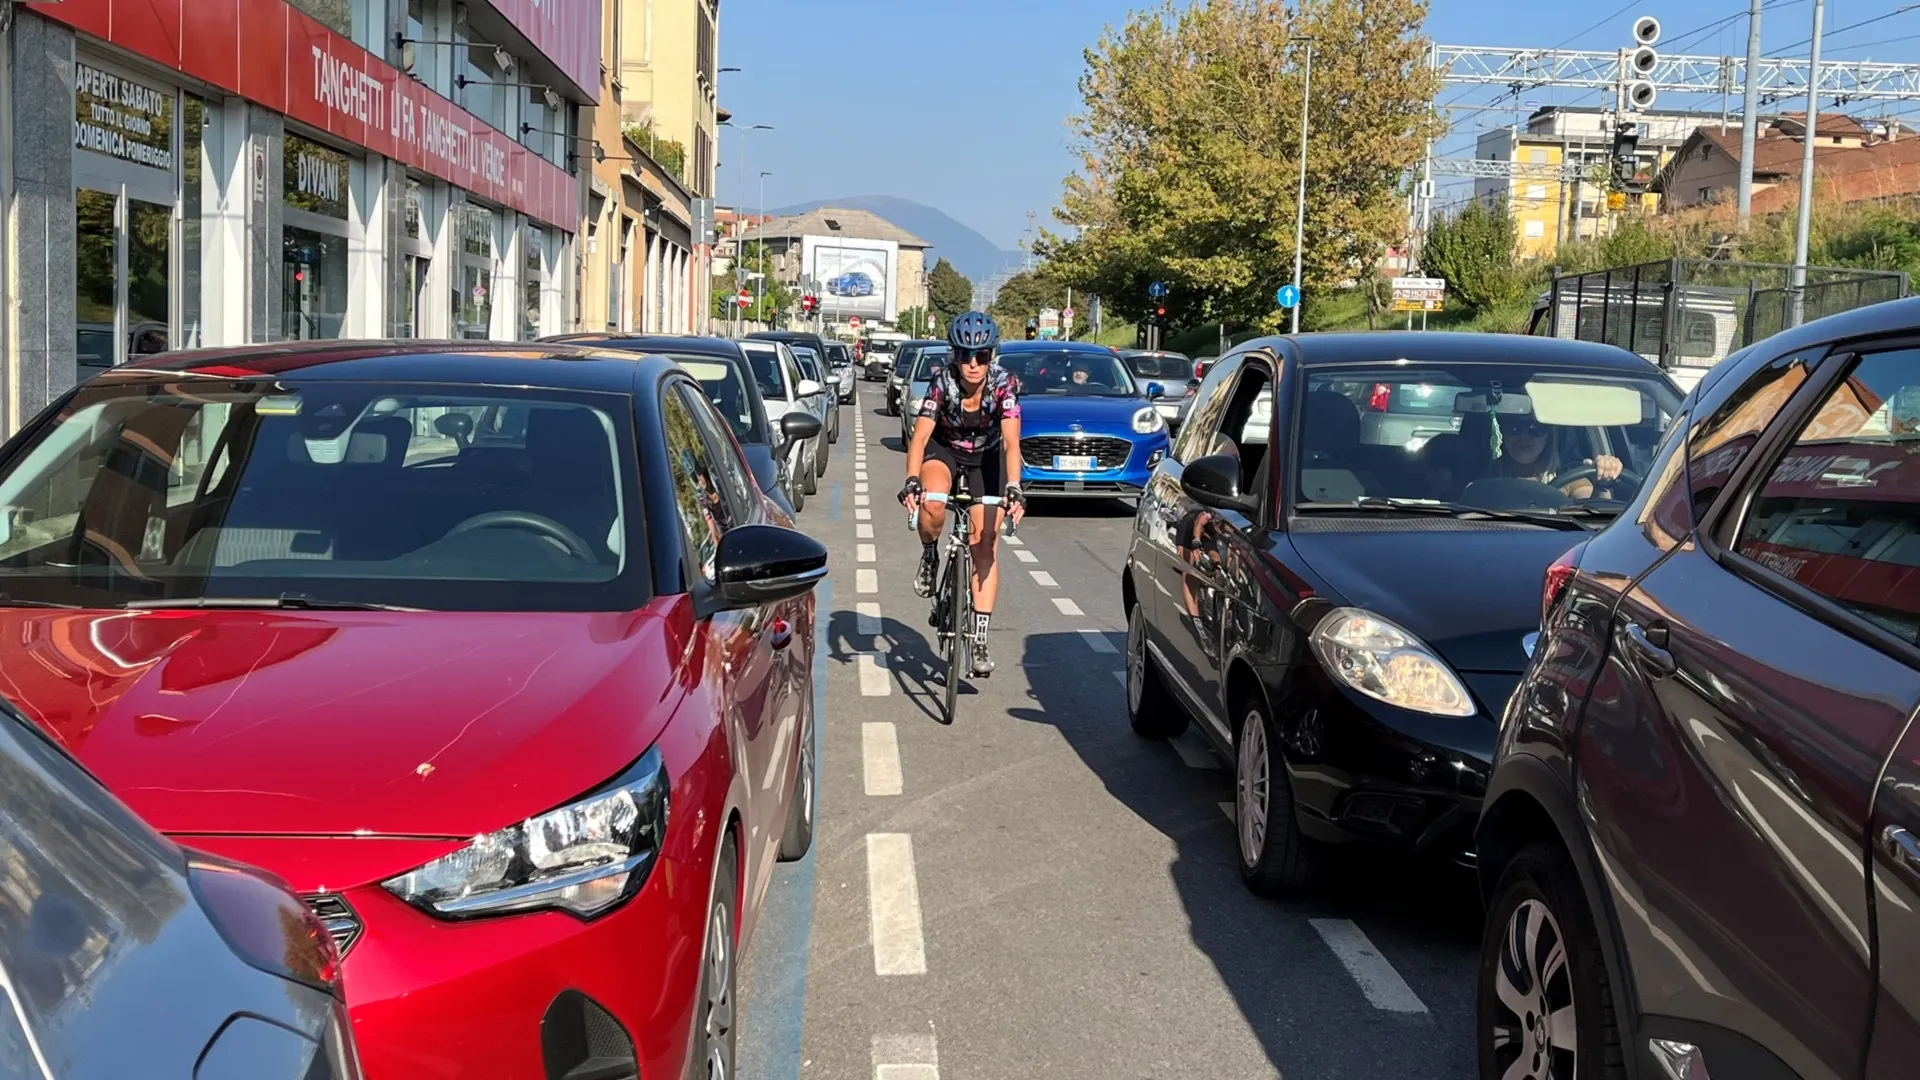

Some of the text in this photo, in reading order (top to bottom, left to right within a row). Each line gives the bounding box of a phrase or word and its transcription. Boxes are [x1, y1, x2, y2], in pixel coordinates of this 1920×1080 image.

[76, 64, 162, 117] APERTI SABATO
[91, 102, 151, 137] TUTTO IL GIORNO
[312, 45, 384, 131] TANGHETTI
[421, 105, 469, 170] TANGHETTI
[481, 141, 504, 187] VENDE
[126, 139, 171, 169] POMERIGGIO
[298, 152, 339, 202] DIVANI
[1411, 289, 1443, 297] HOSTEL
